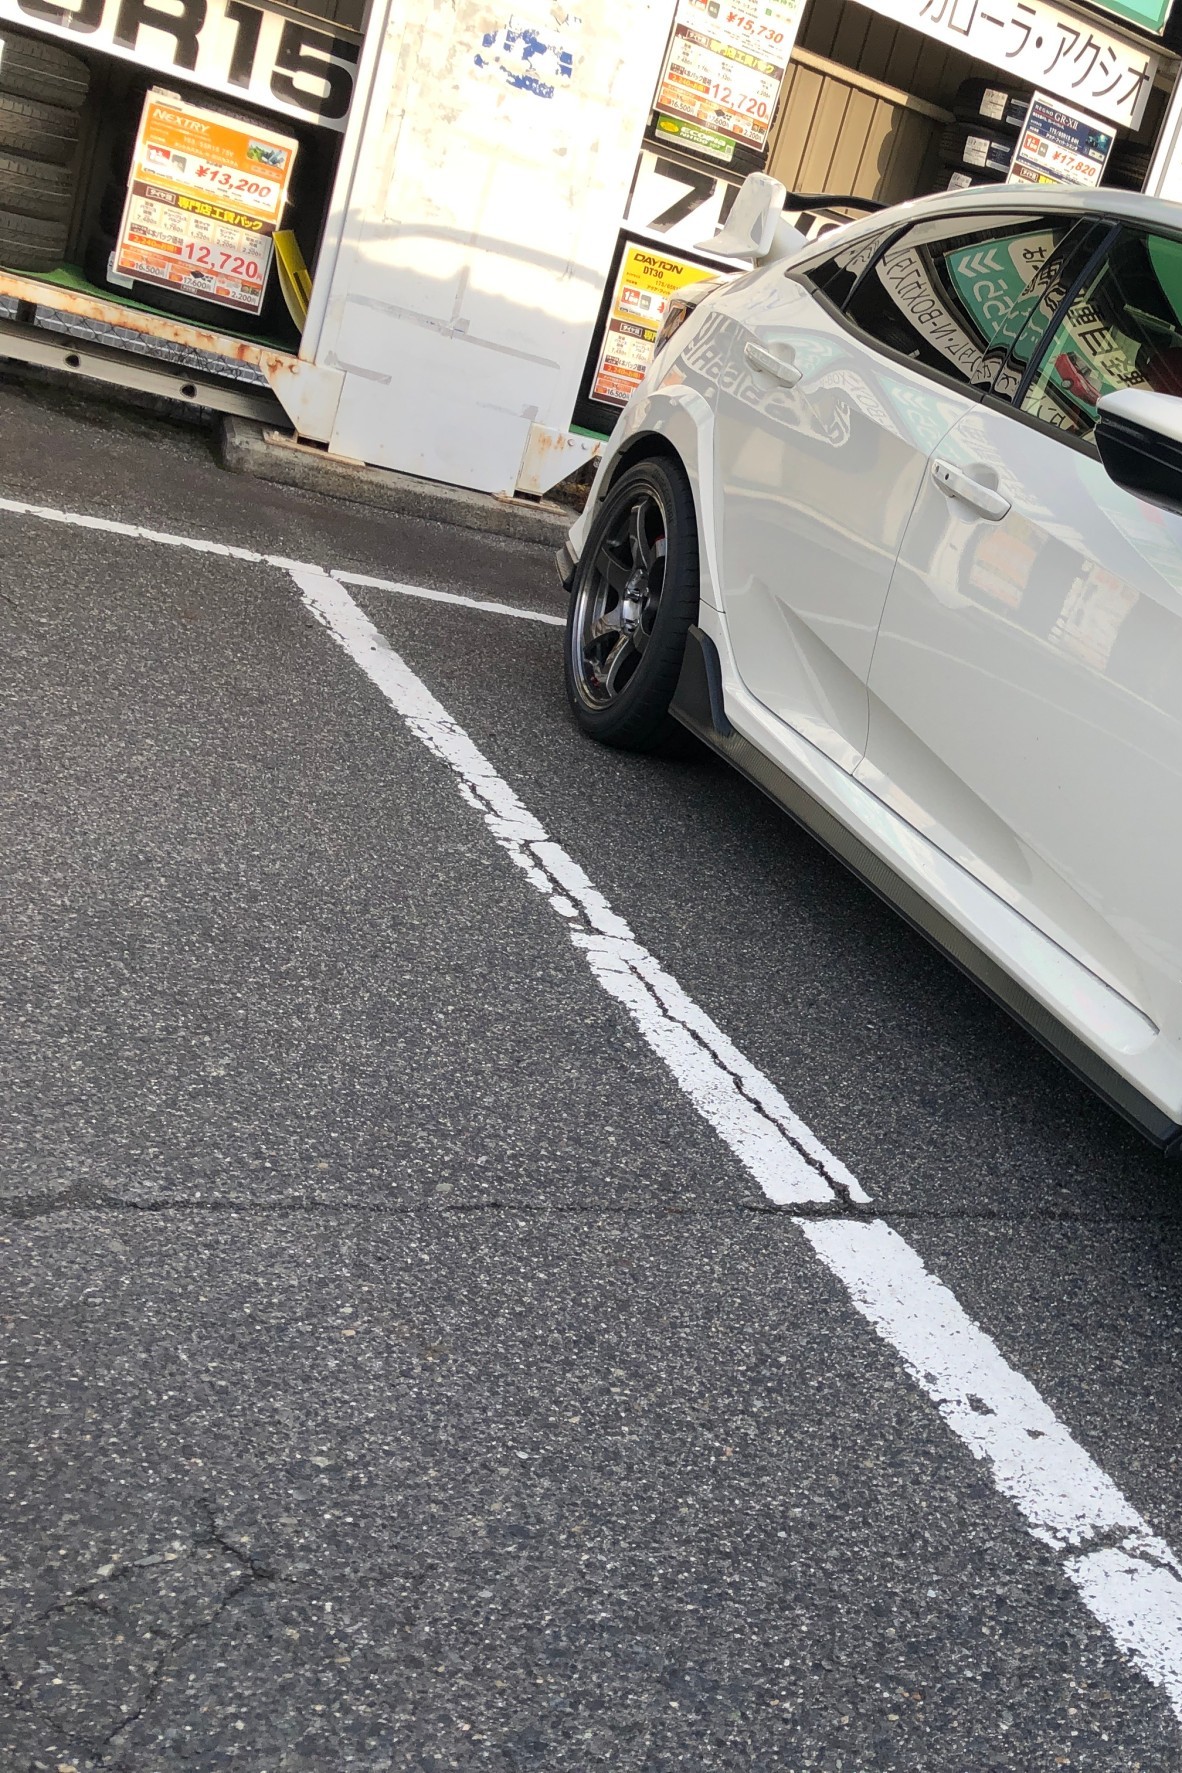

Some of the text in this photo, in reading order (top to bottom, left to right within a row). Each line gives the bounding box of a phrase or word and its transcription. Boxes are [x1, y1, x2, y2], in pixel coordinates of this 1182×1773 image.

[726, 11, 784, 44] ¥15,730
[153, 108, 210, 133] NEXTRY
[1051, 150, 1097, 177] ¥17,820
[194, 165, 272, 199] ¥13,200
[633, 253, 683, 275] DAYTON
[643, 266, 664, 279] DT30
